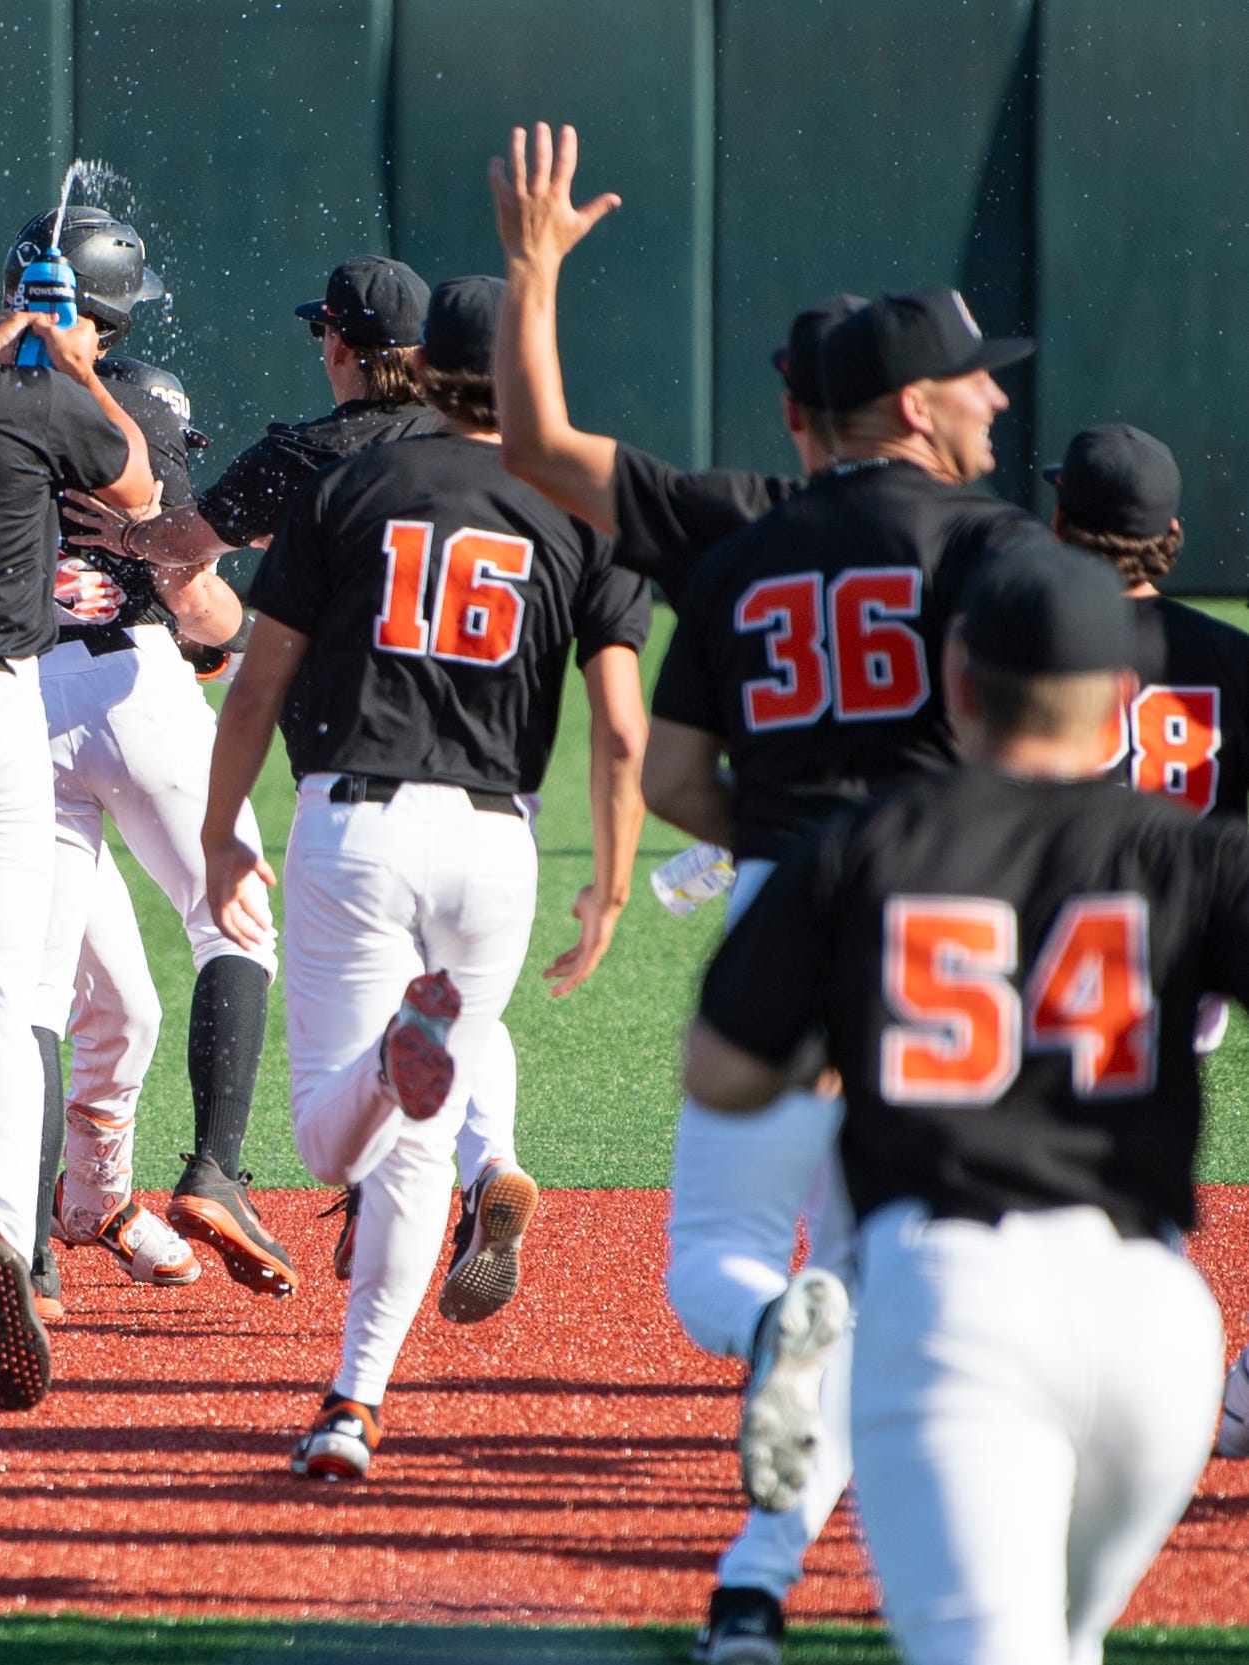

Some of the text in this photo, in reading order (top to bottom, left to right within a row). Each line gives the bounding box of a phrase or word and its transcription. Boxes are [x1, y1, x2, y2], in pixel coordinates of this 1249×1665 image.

[373, 519, 533, 667] 16
[734, 567, 930, 731] 36
[882, 893, 1155, 1103] 54
